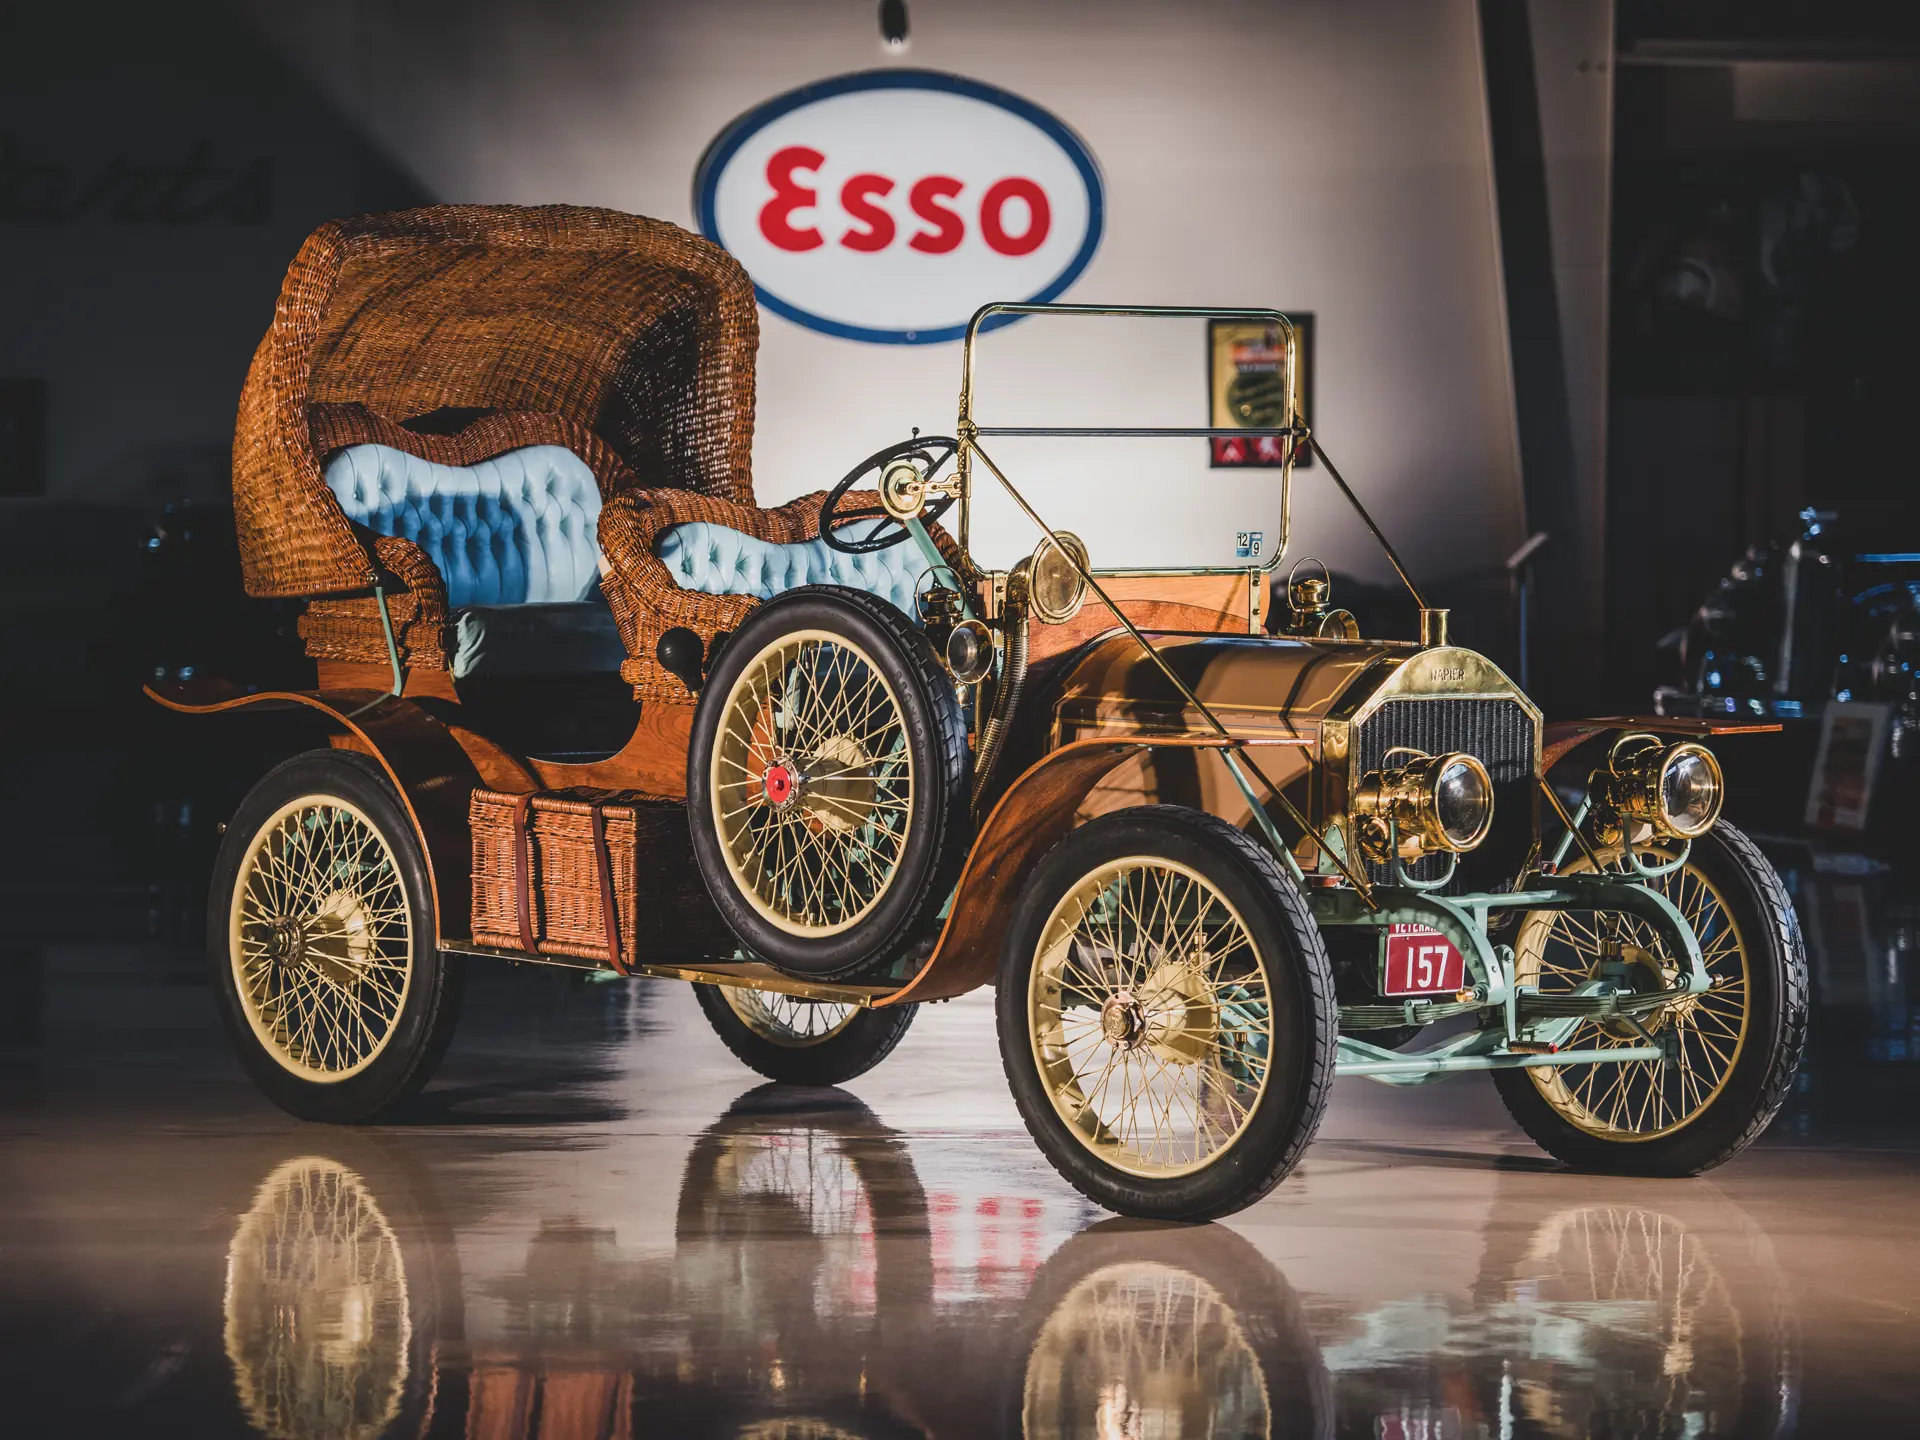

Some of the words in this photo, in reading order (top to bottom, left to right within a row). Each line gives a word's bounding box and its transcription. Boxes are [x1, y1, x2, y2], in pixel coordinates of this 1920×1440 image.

[1237, 533, 1248, 547] 12
[1430, 667, 1465, 681] NAPIER
[1406, 945, 1449, 989] 157
